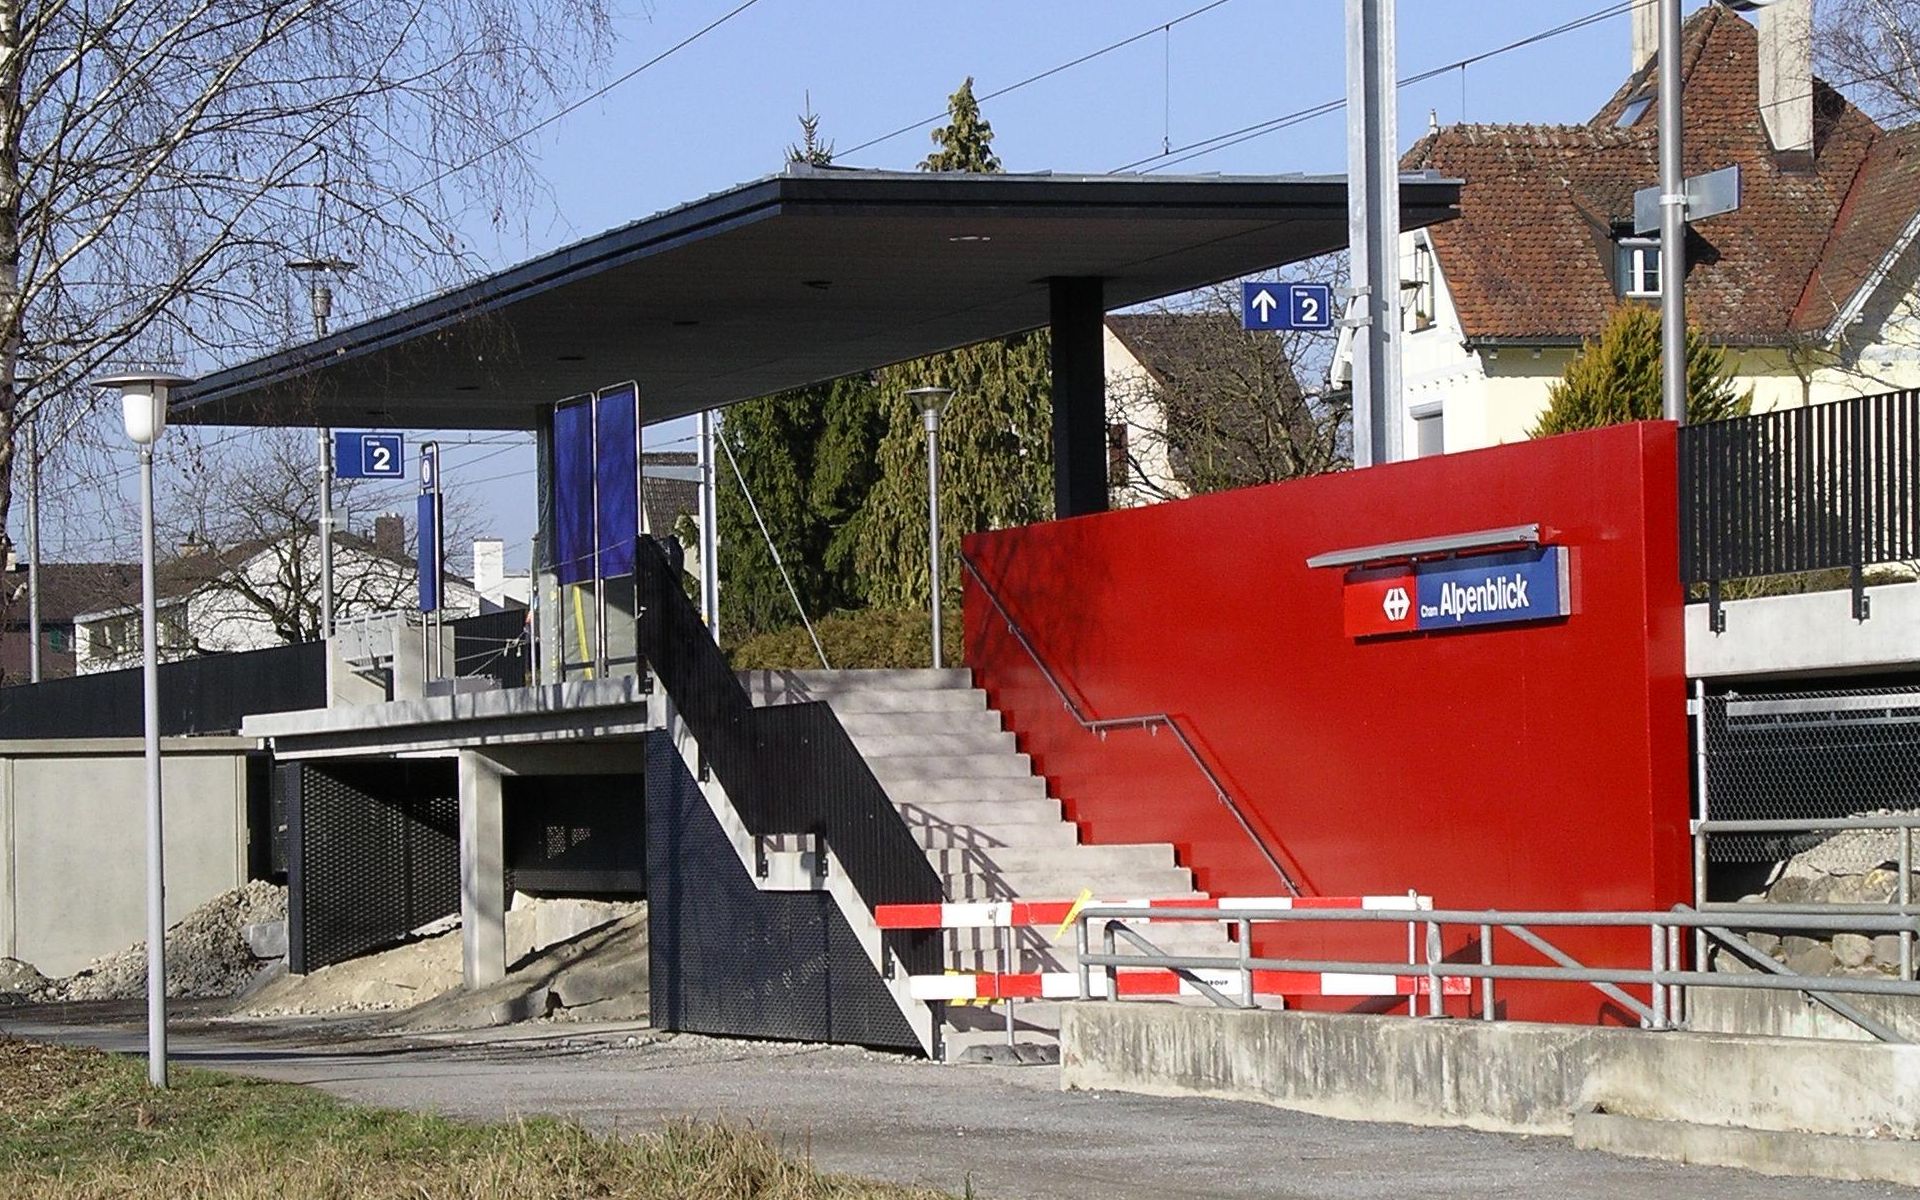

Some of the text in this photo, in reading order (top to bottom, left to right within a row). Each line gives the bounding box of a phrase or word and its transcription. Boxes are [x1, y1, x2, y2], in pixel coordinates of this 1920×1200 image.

[1302, 297, 1318, 322] 2
[373, 447, 390, 470] 2
[1440, 573, 1530, 622] Alpenblick
